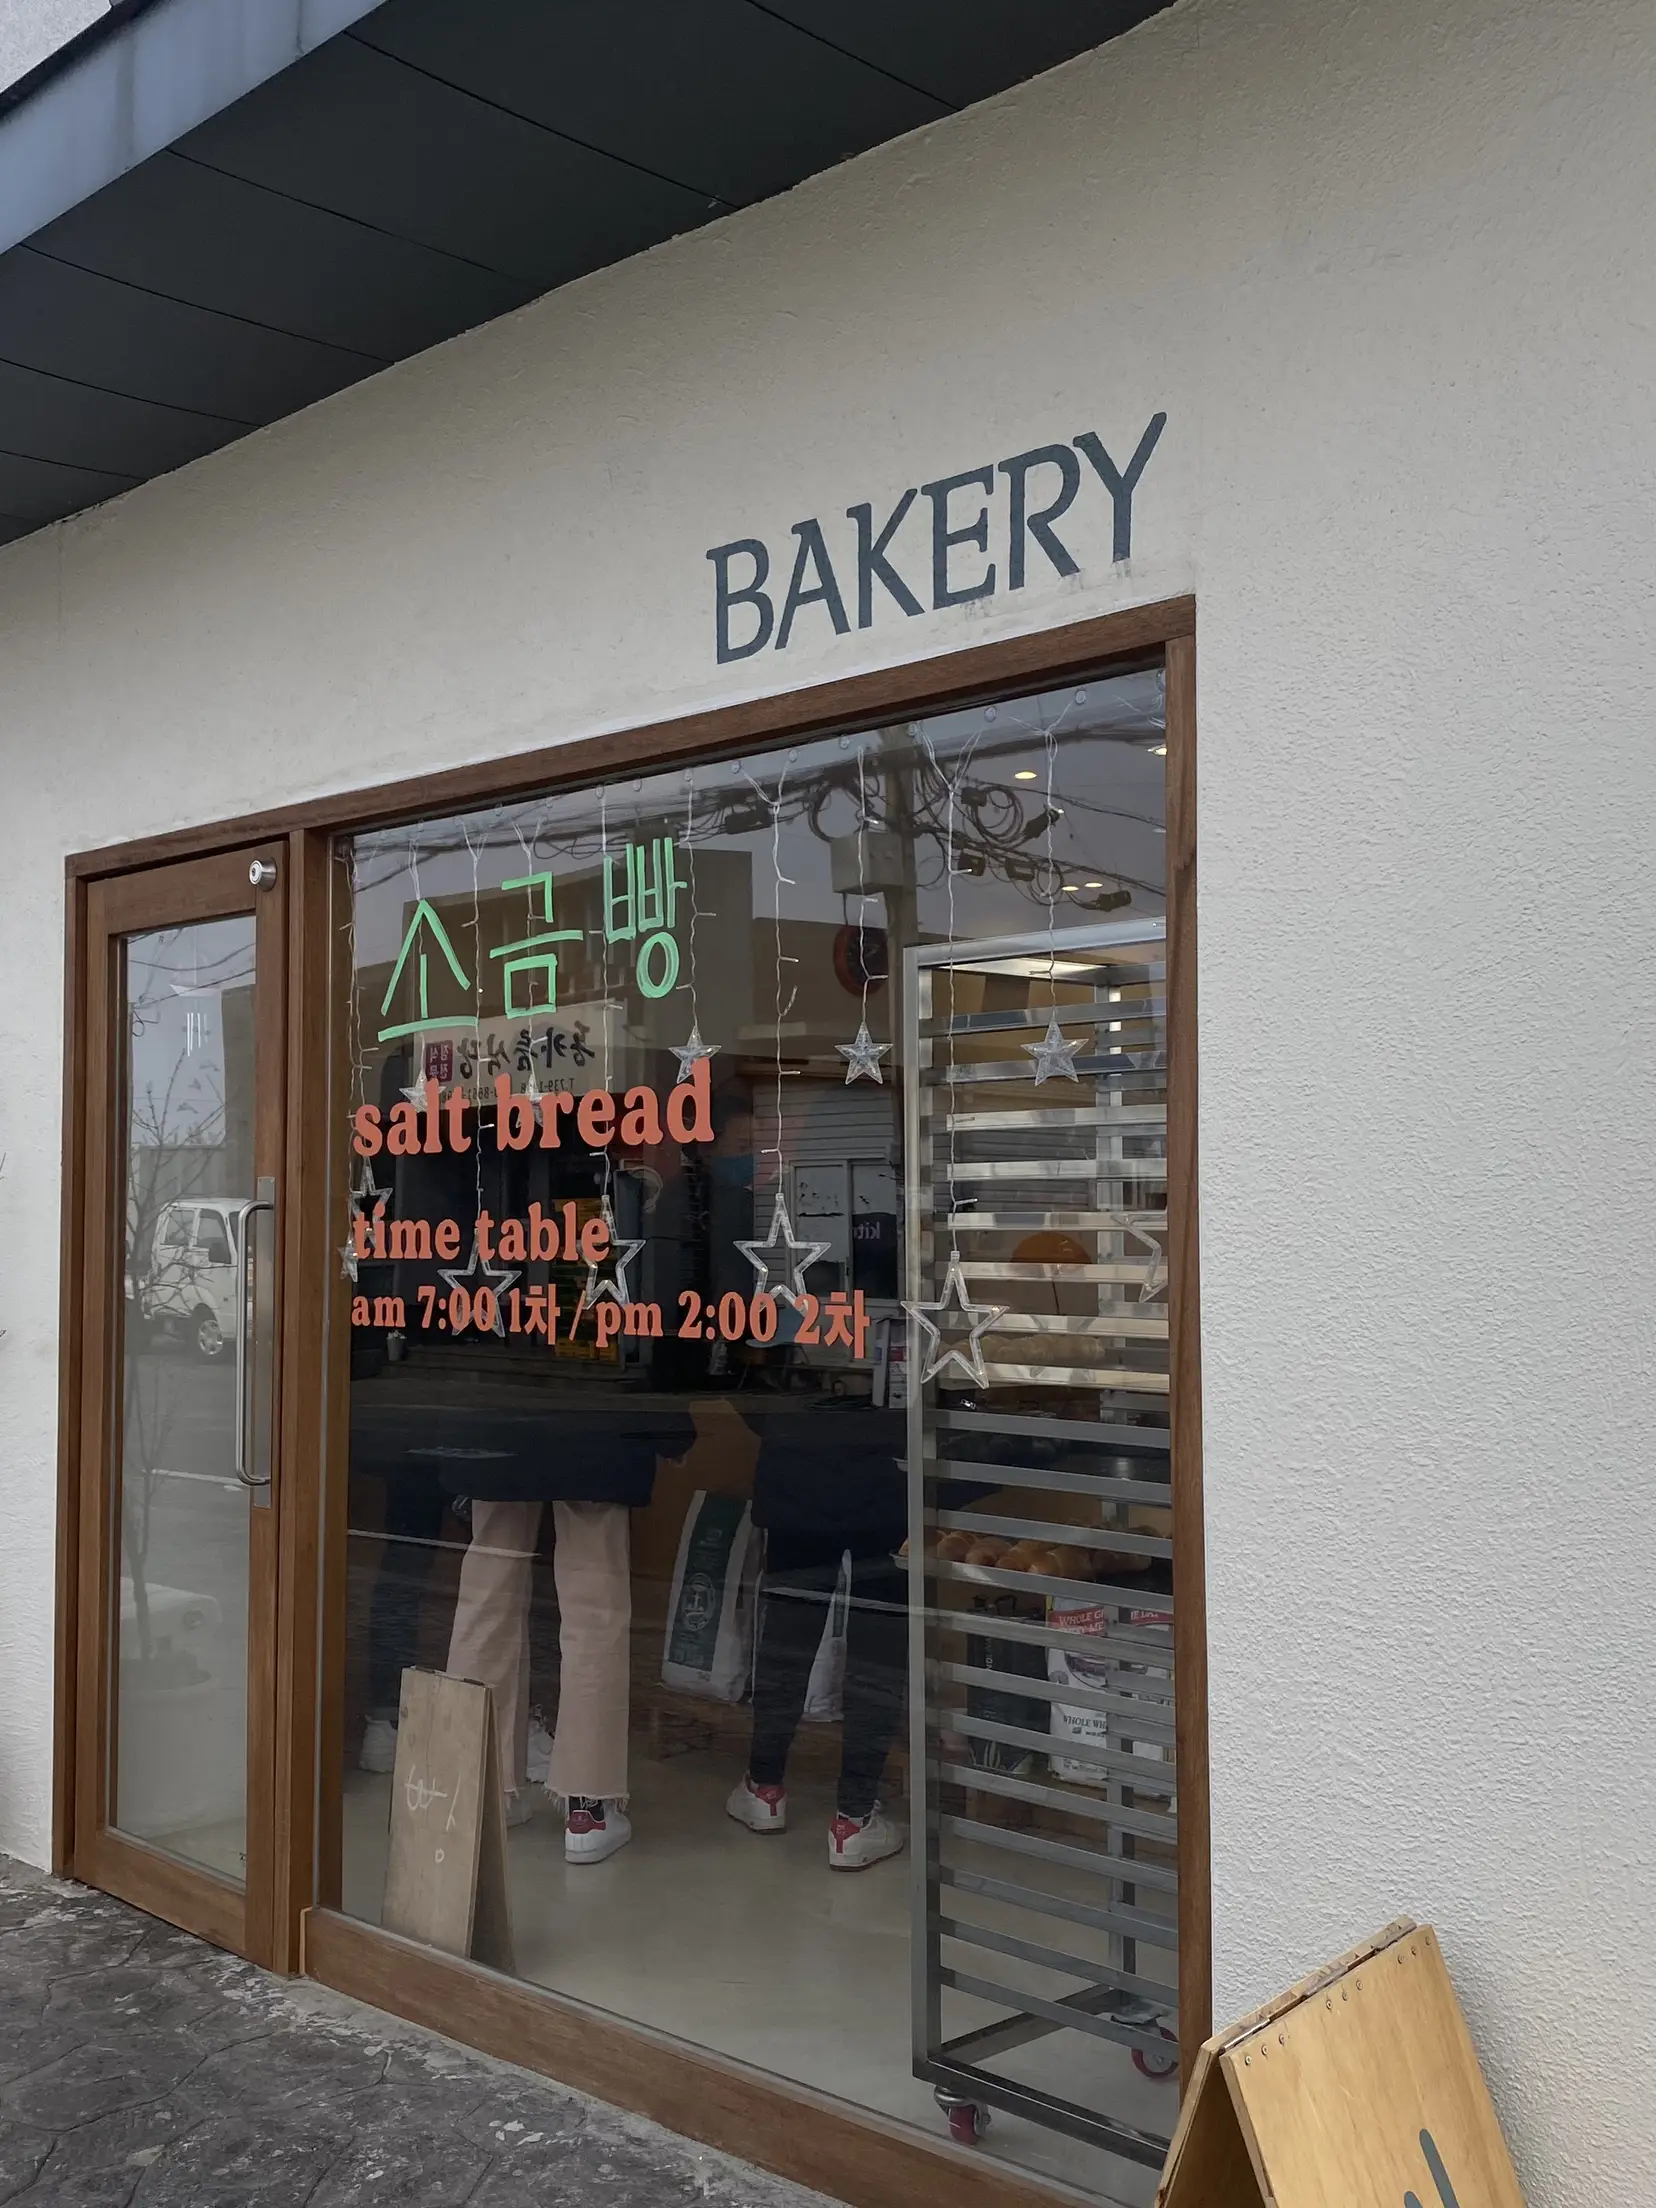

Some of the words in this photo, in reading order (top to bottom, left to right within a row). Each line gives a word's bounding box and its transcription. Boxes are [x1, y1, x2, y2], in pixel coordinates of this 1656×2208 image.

[706, 411, 1167, 664] BAKERY
[377, 837, 687, 1042] 소금빵
[353, 1079, 471, 1156] salt
[496, 1056, 715, 1151] bread
[352, 1202, 461, 1260] time
[477, 1201, 610, 1261] table
[352, 1295, 406, 1328] am
[417, 1285, 496, 1331] 7:00
[509, 1284, 561, 1345] 1차
[596, 1299, 663, 1348] pm
[678, 1290, 777, 1343] 2:00
[793, 1290, 870, 1359] 2차
[1059, 1610, 1093, 1626] WHOLE
